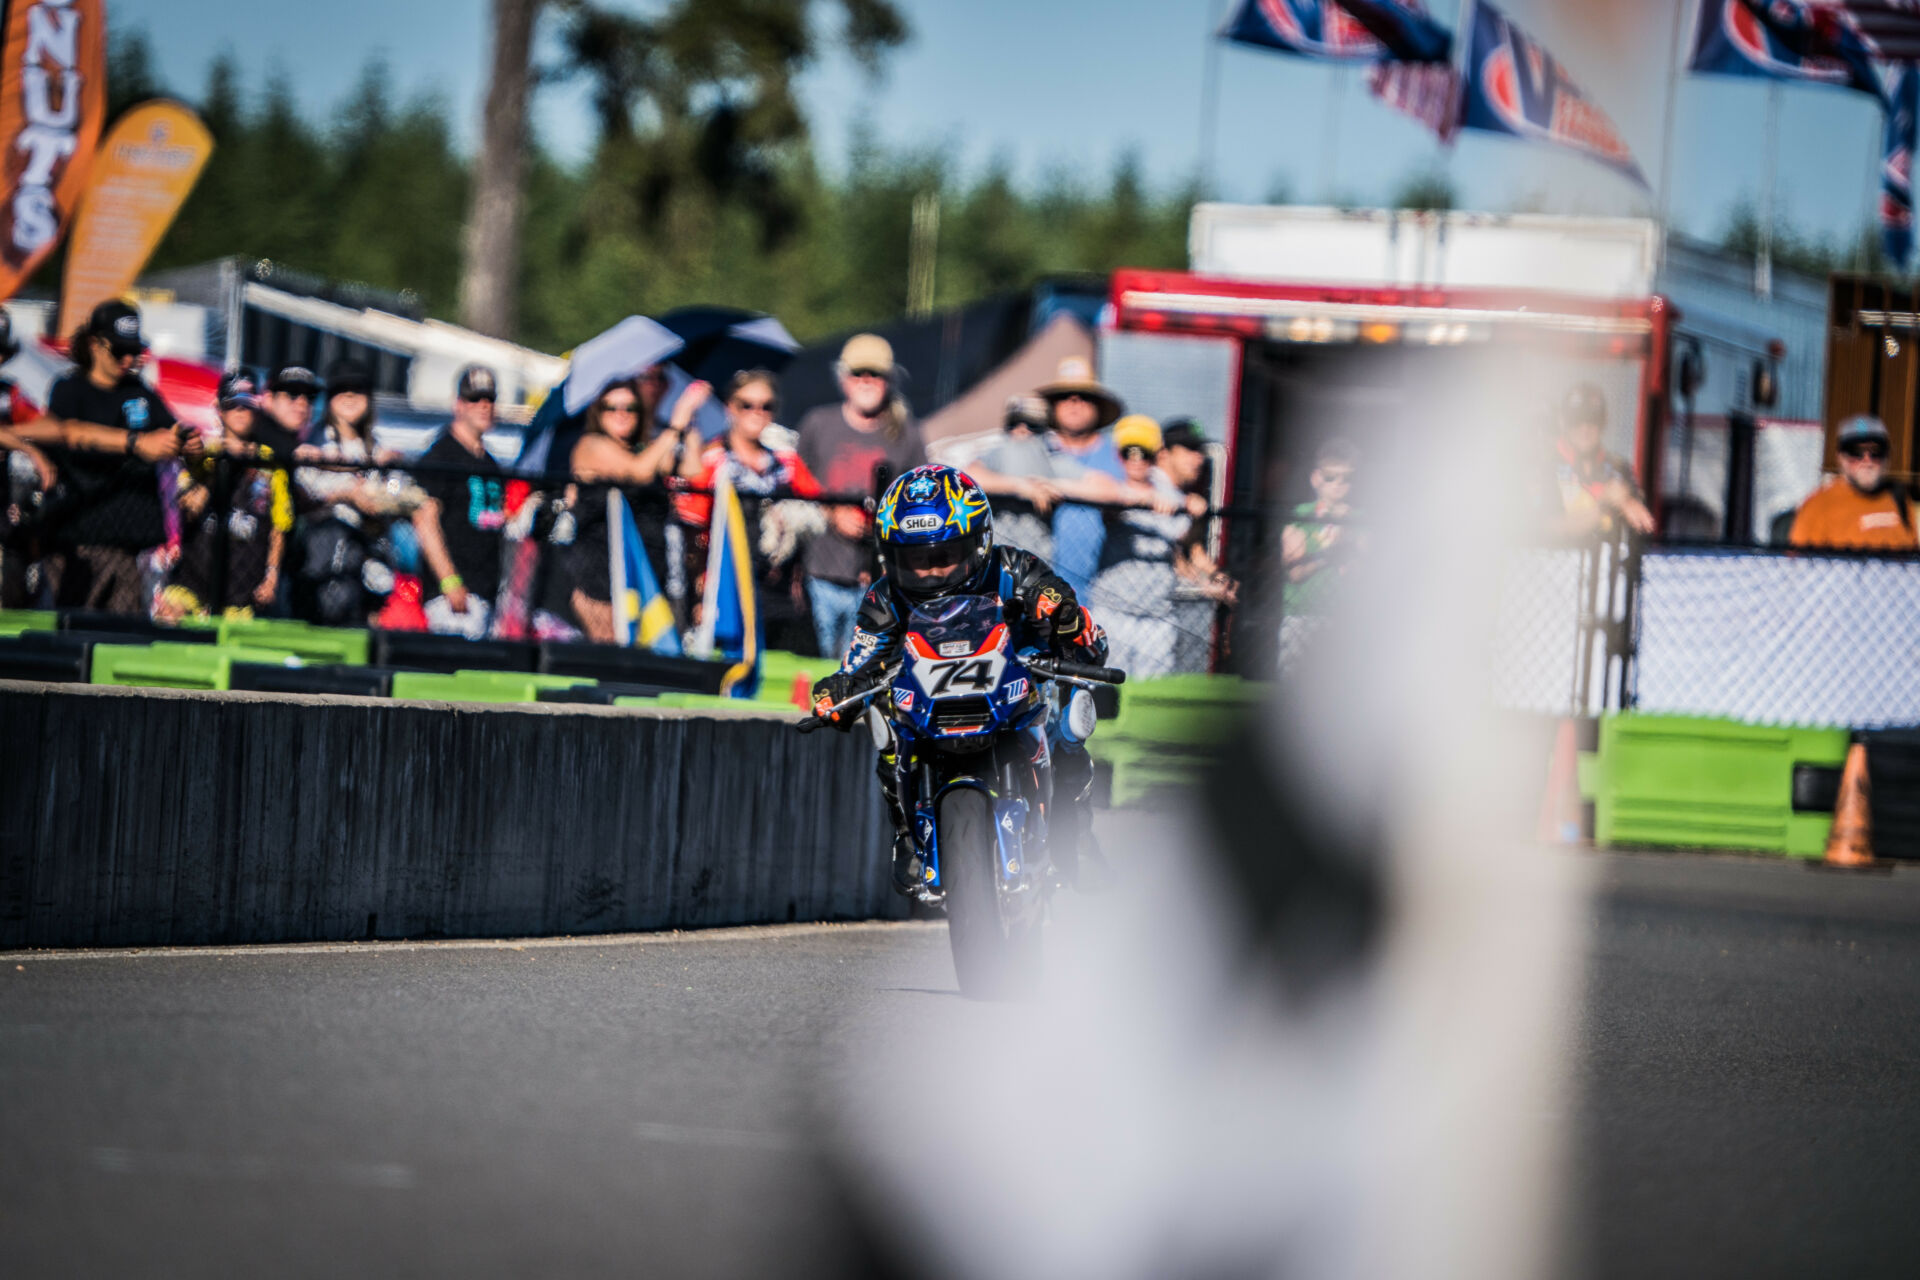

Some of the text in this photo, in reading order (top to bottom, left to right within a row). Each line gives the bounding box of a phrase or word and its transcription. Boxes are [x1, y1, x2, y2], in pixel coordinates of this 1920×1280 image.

[12, 0, 82, 252] NUTS
[906, 518, 937, 529] SHOEI
[929, 659, 995, 697] 74
